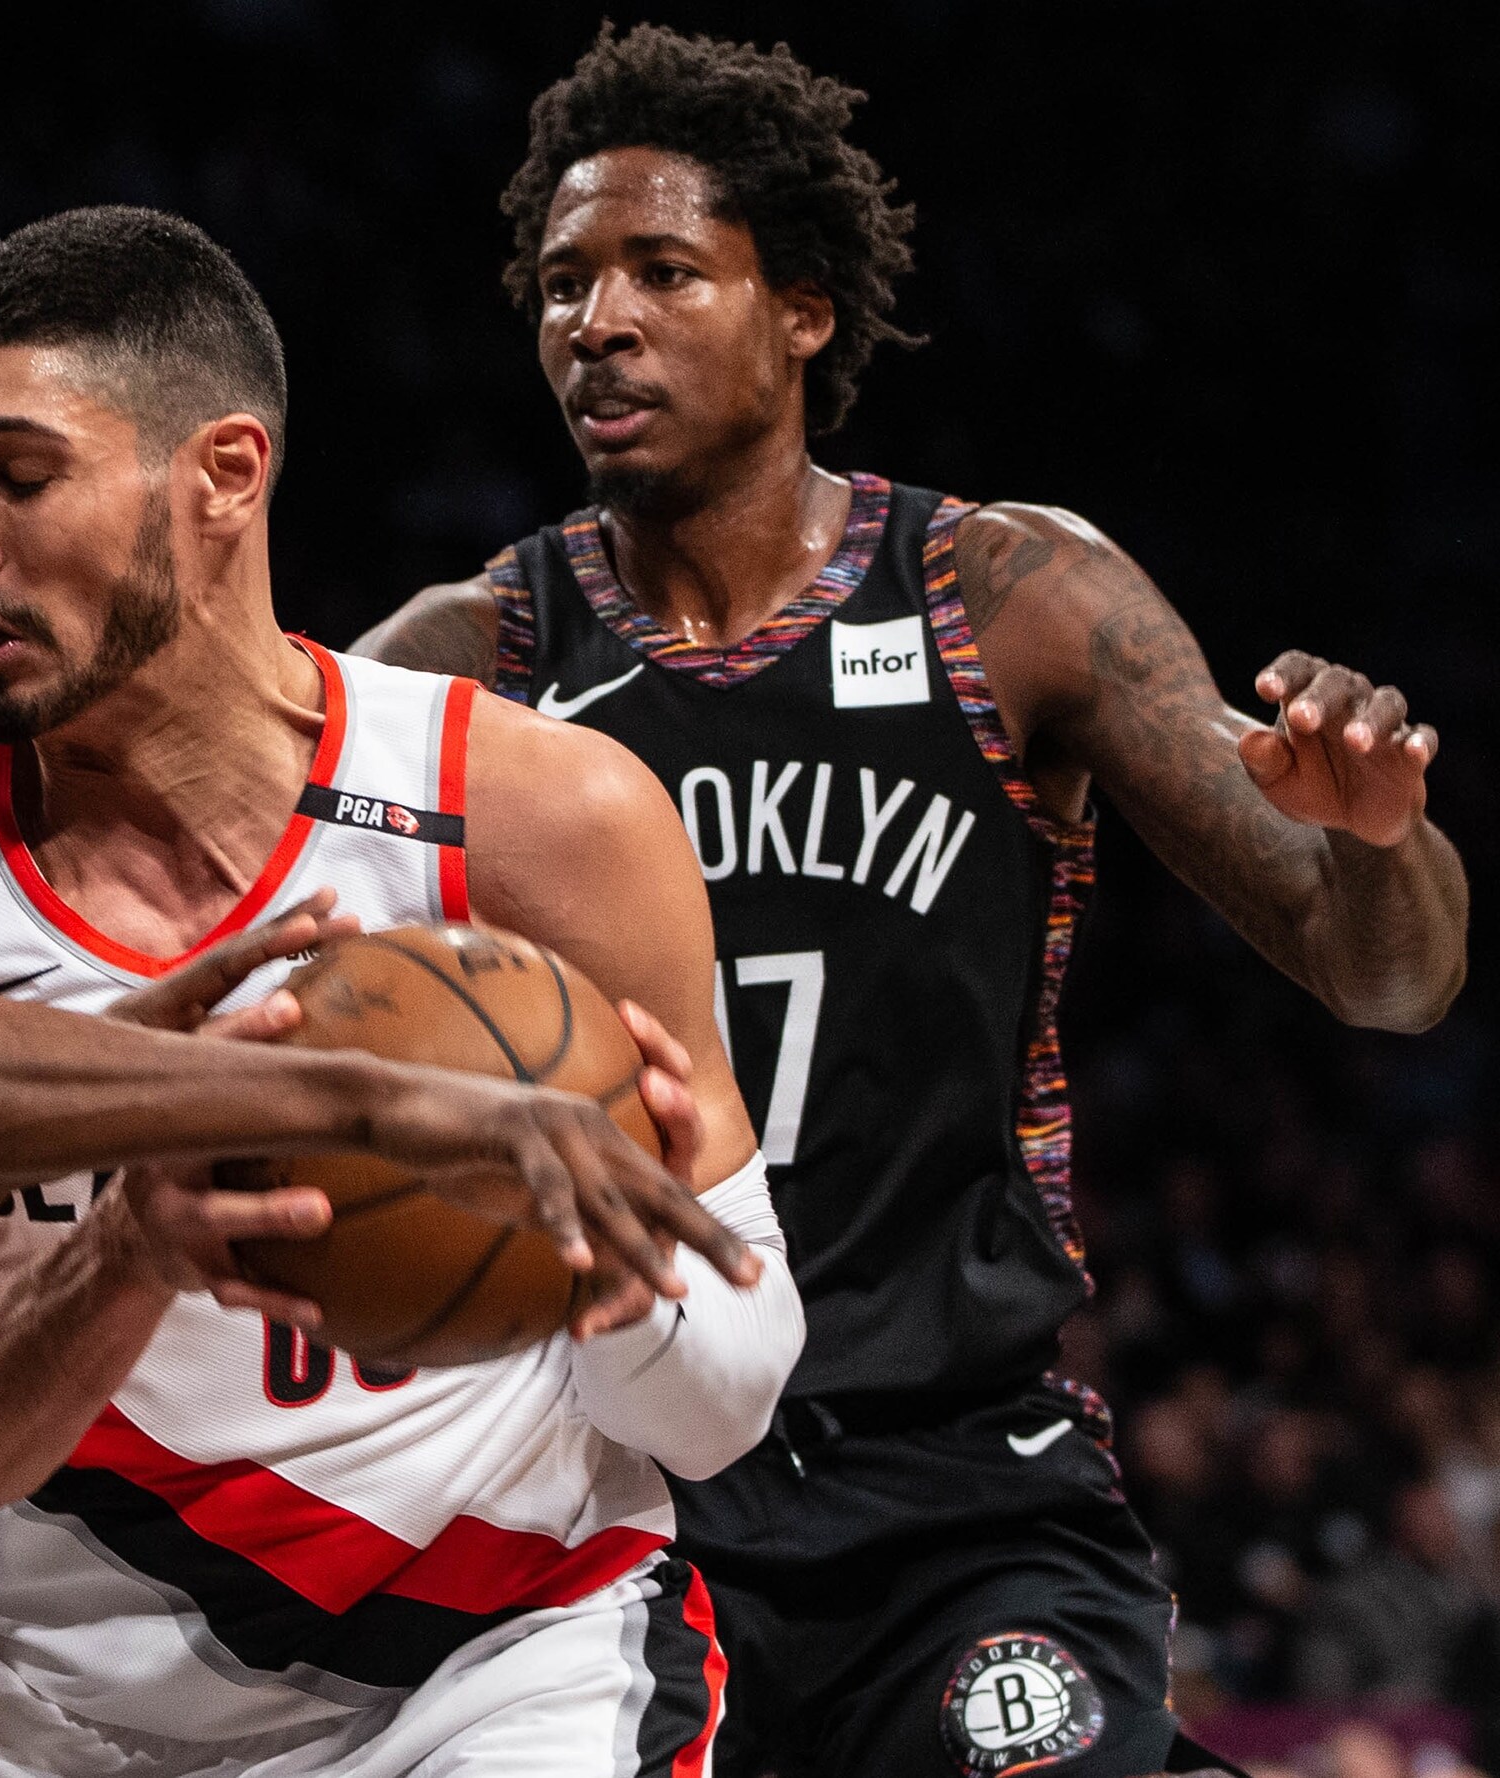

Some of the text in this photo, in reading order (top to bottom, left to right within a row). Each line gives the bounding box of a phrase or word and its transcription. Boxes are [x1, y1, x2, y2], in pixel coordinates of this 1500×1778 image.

[840, 648, 918, 675] infor
[335, 794, 384, 828] PGA
[680, 760, 975, 915] OKLYN
[994, 1673, 1036, 1738] B
